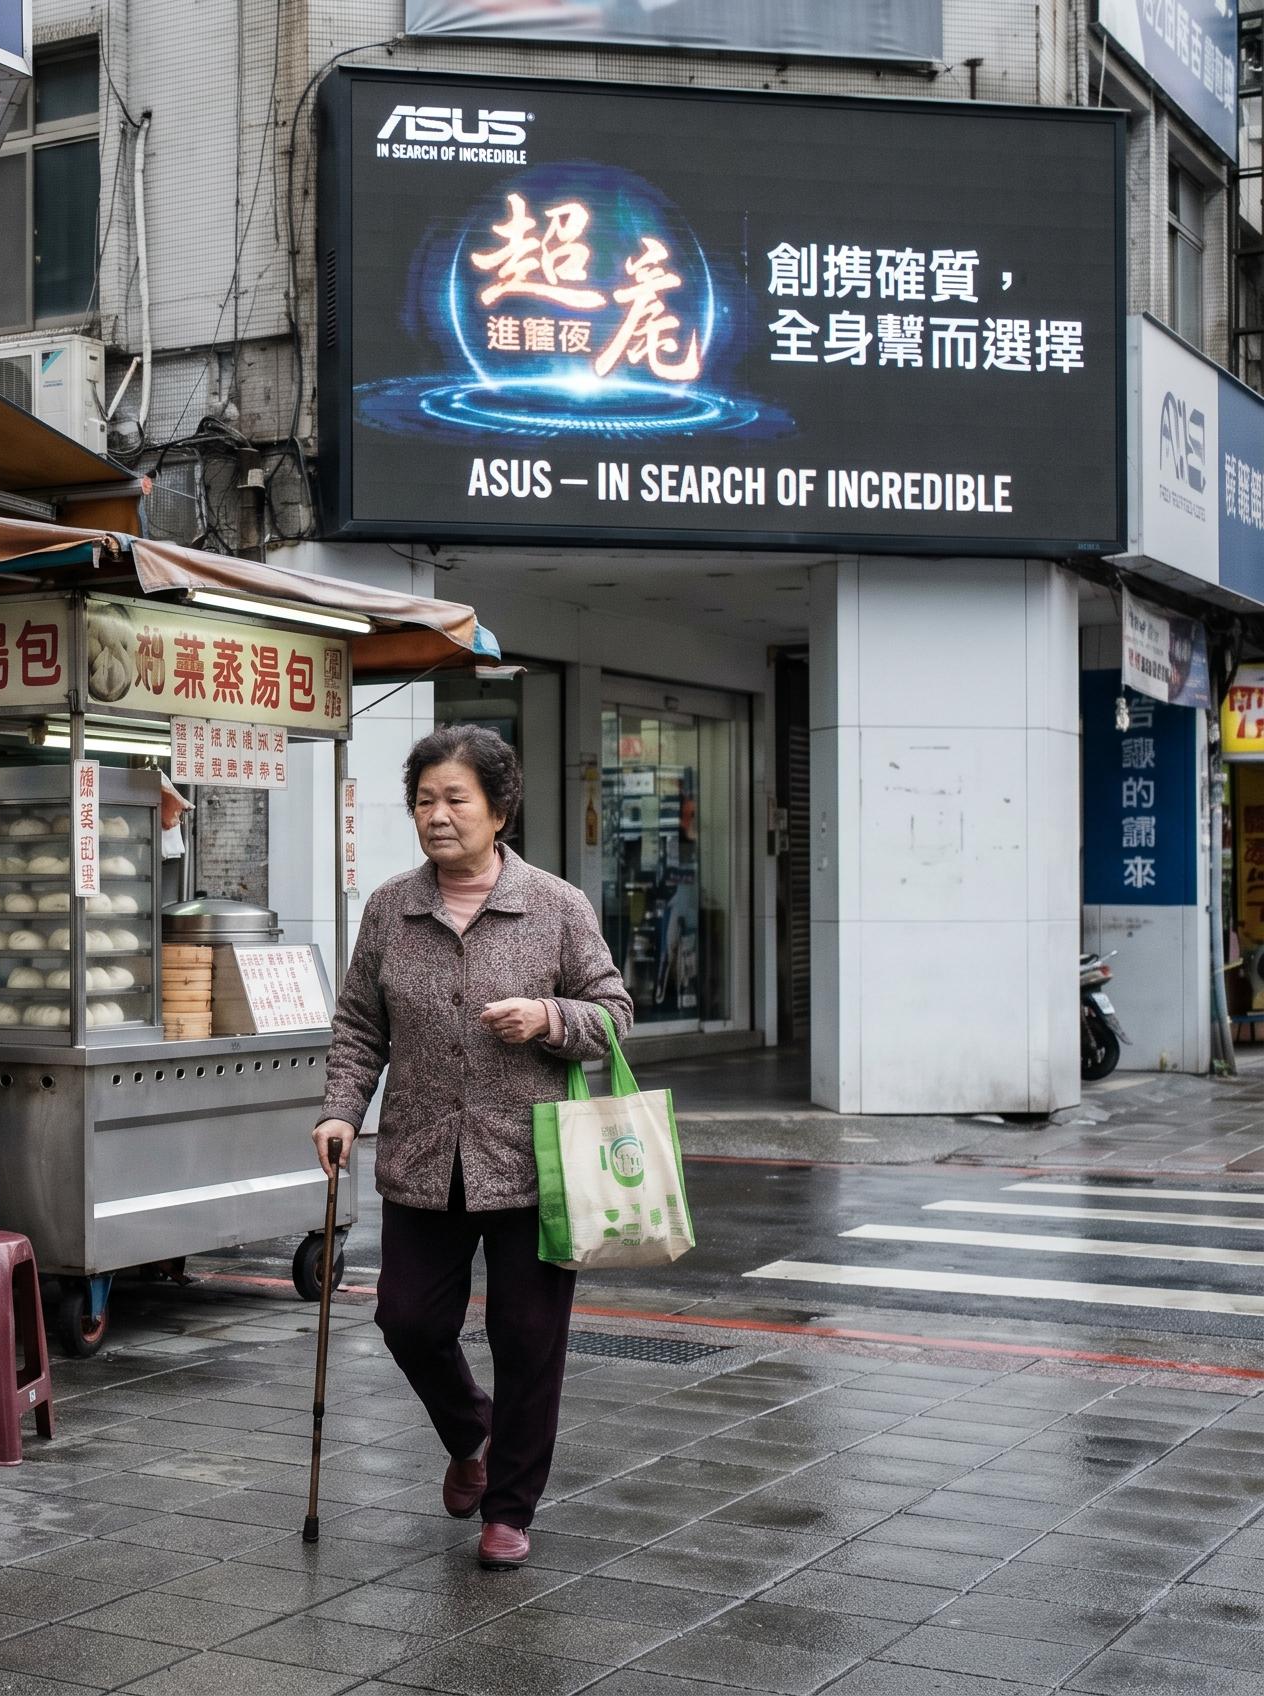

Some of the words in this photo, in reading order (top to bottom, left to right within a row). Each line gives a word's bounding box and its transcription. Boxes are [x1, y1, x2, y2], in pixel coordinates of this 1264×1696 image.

[377, 105, 527, 145] ASUS
[377, 143, 389, 157] IN
[392, 145, 437, 160] SEARCH
[440, 147, 456, 160] OF
[459, 147, 527, 164] INCREDIBLE
[467, 458, 552, 498] ASUS
[598, 462, 629, 501] IN
[640, 463, 766, 505] SEARCH
[777, 468, 817, 507] OF
[827, 470, 1013, 513] INCREDIBLE
